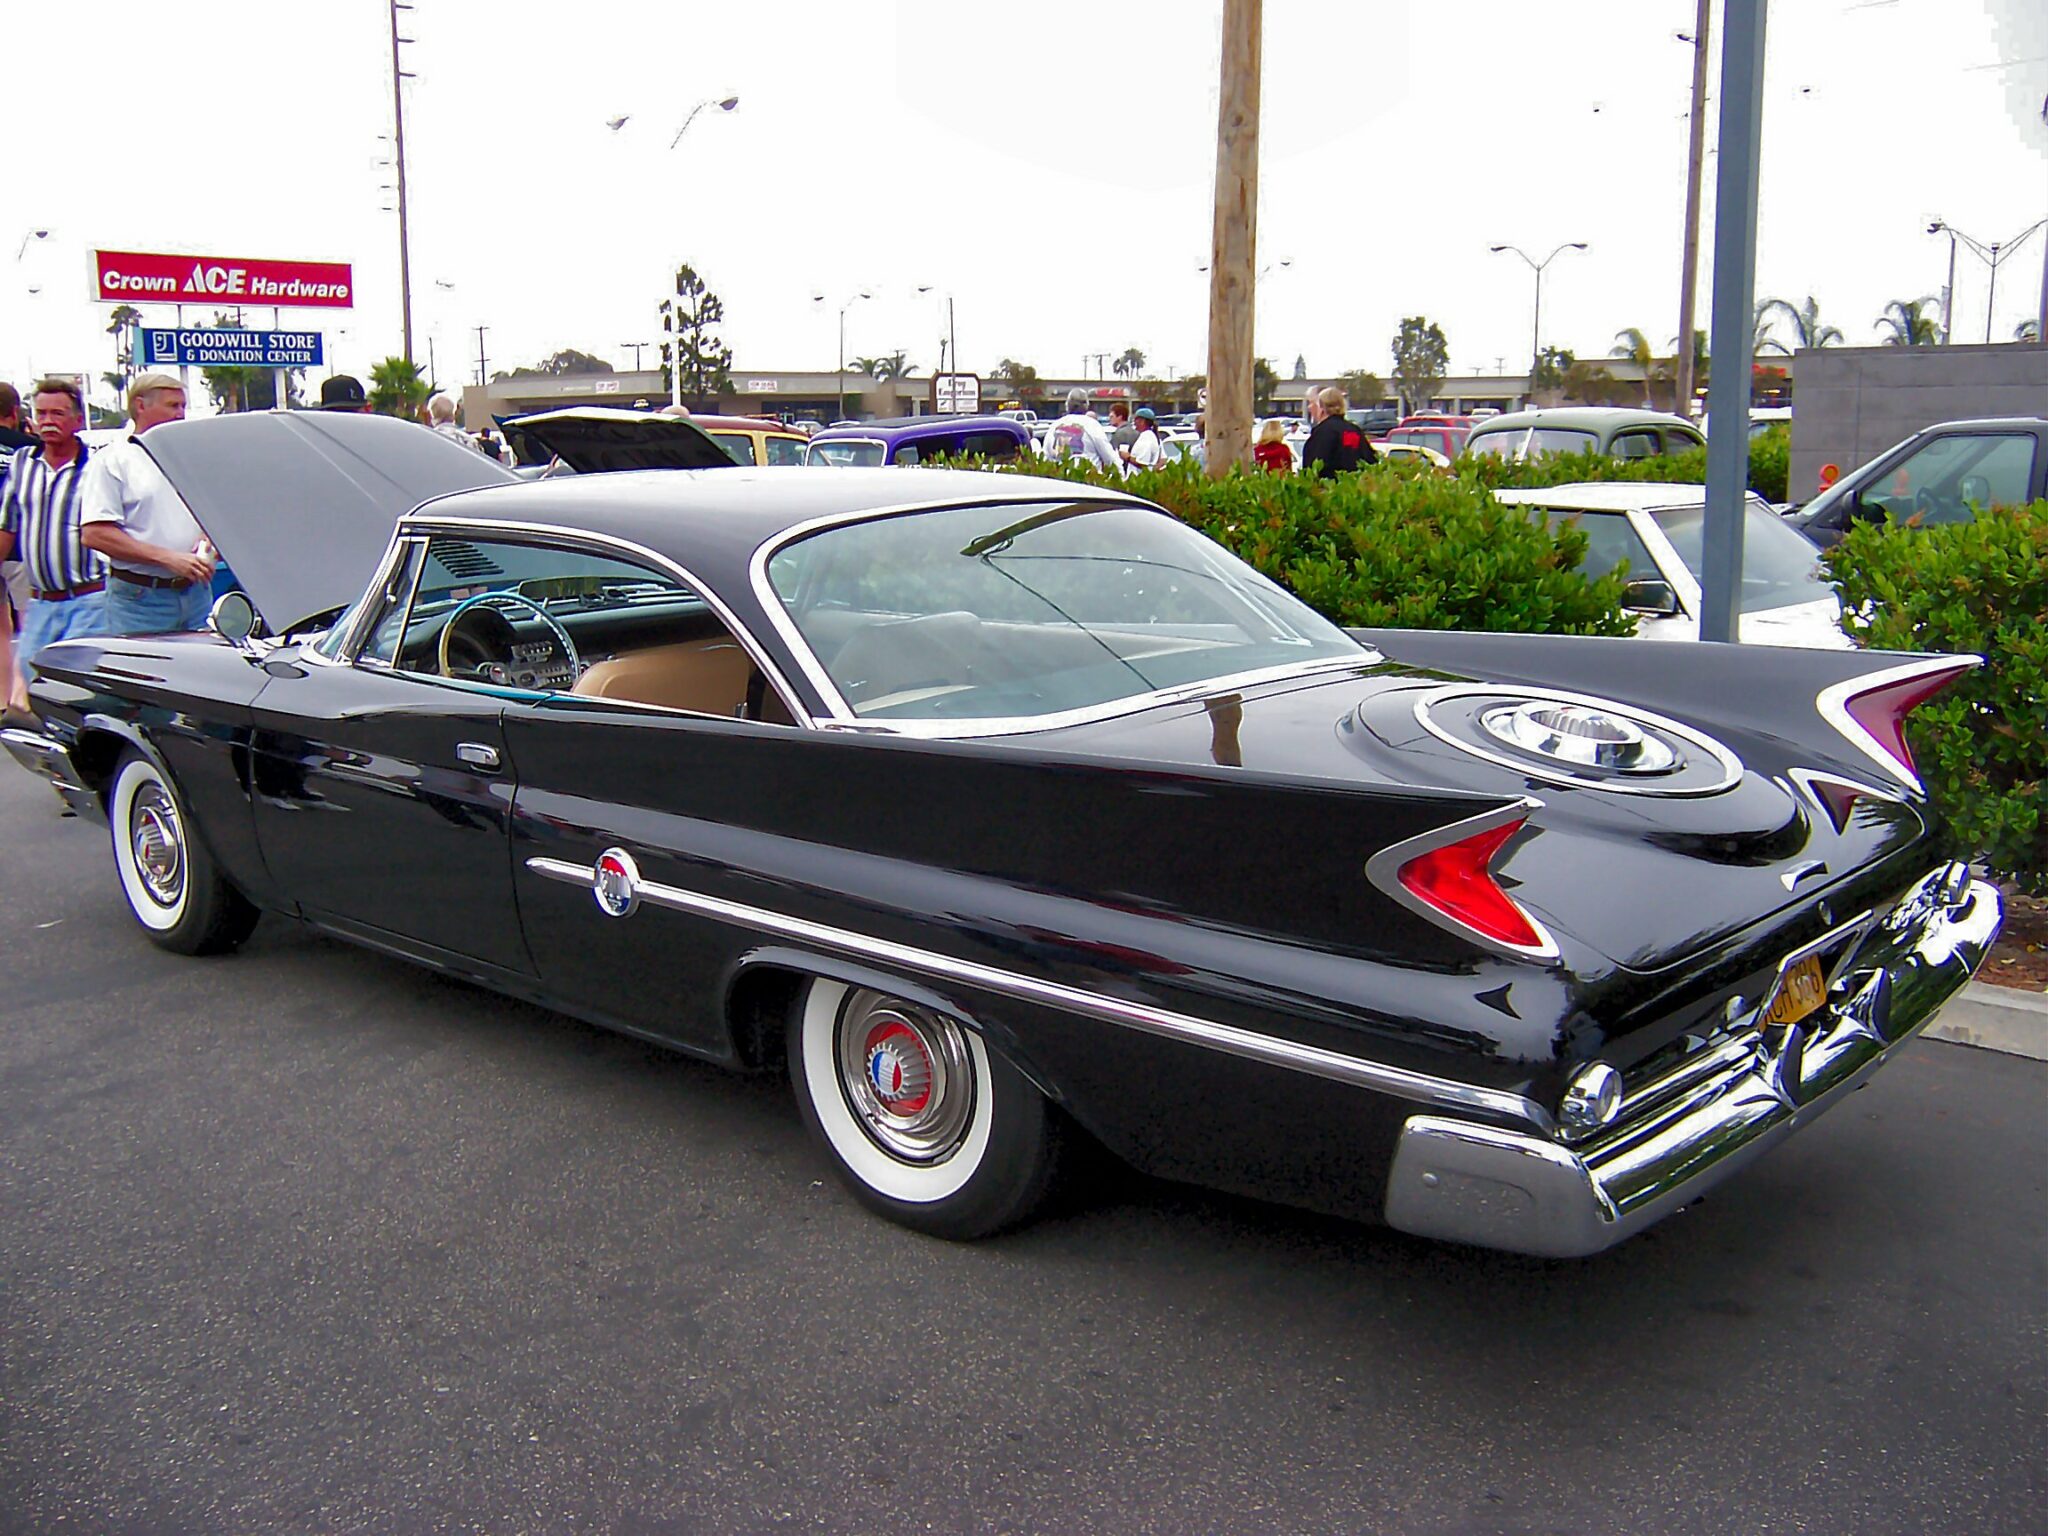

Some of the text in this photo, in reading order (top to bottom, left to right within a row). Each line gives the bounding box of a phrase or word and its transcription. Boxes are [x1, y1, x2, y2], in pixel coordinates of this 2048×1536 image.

[103, 263, 348, 298] Crown ACE Hardware
[179, 332, 316, 349] GOODWILL STORE
[186, 349, 312, 363] & DONATION CENTER
